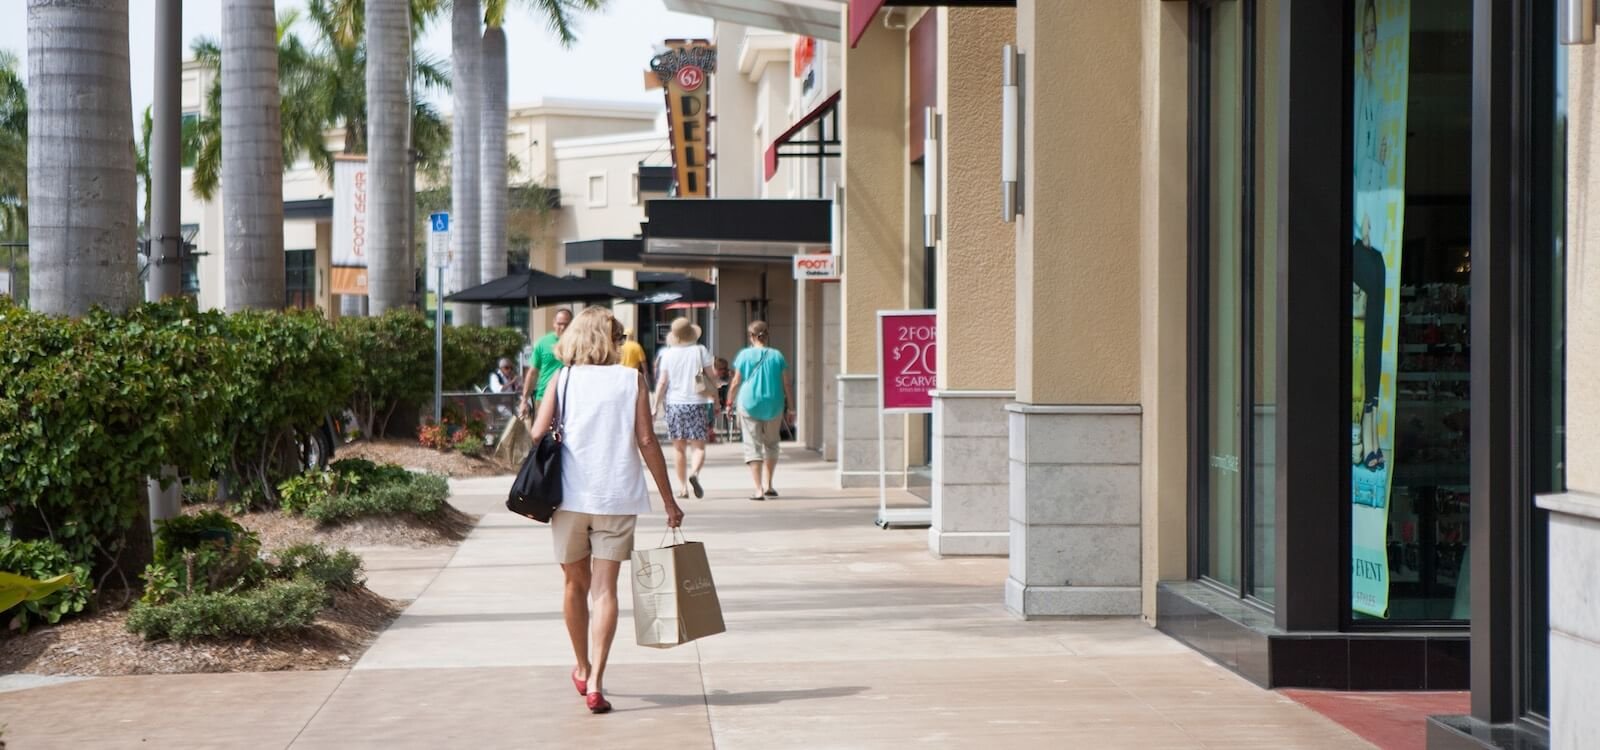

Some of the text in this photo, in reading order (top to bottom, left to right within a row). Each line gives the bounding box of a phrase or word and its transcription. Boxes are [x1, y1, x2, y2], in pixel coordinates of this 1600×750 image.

[680, 70, 700, 87] 62
[681, 95, 705, 193] DELI
[353, 171, 367, 257] FOOT GEAR
[798, 259, 828, 270] FOOT
[1356, 558, 1382, 582] EVENT
